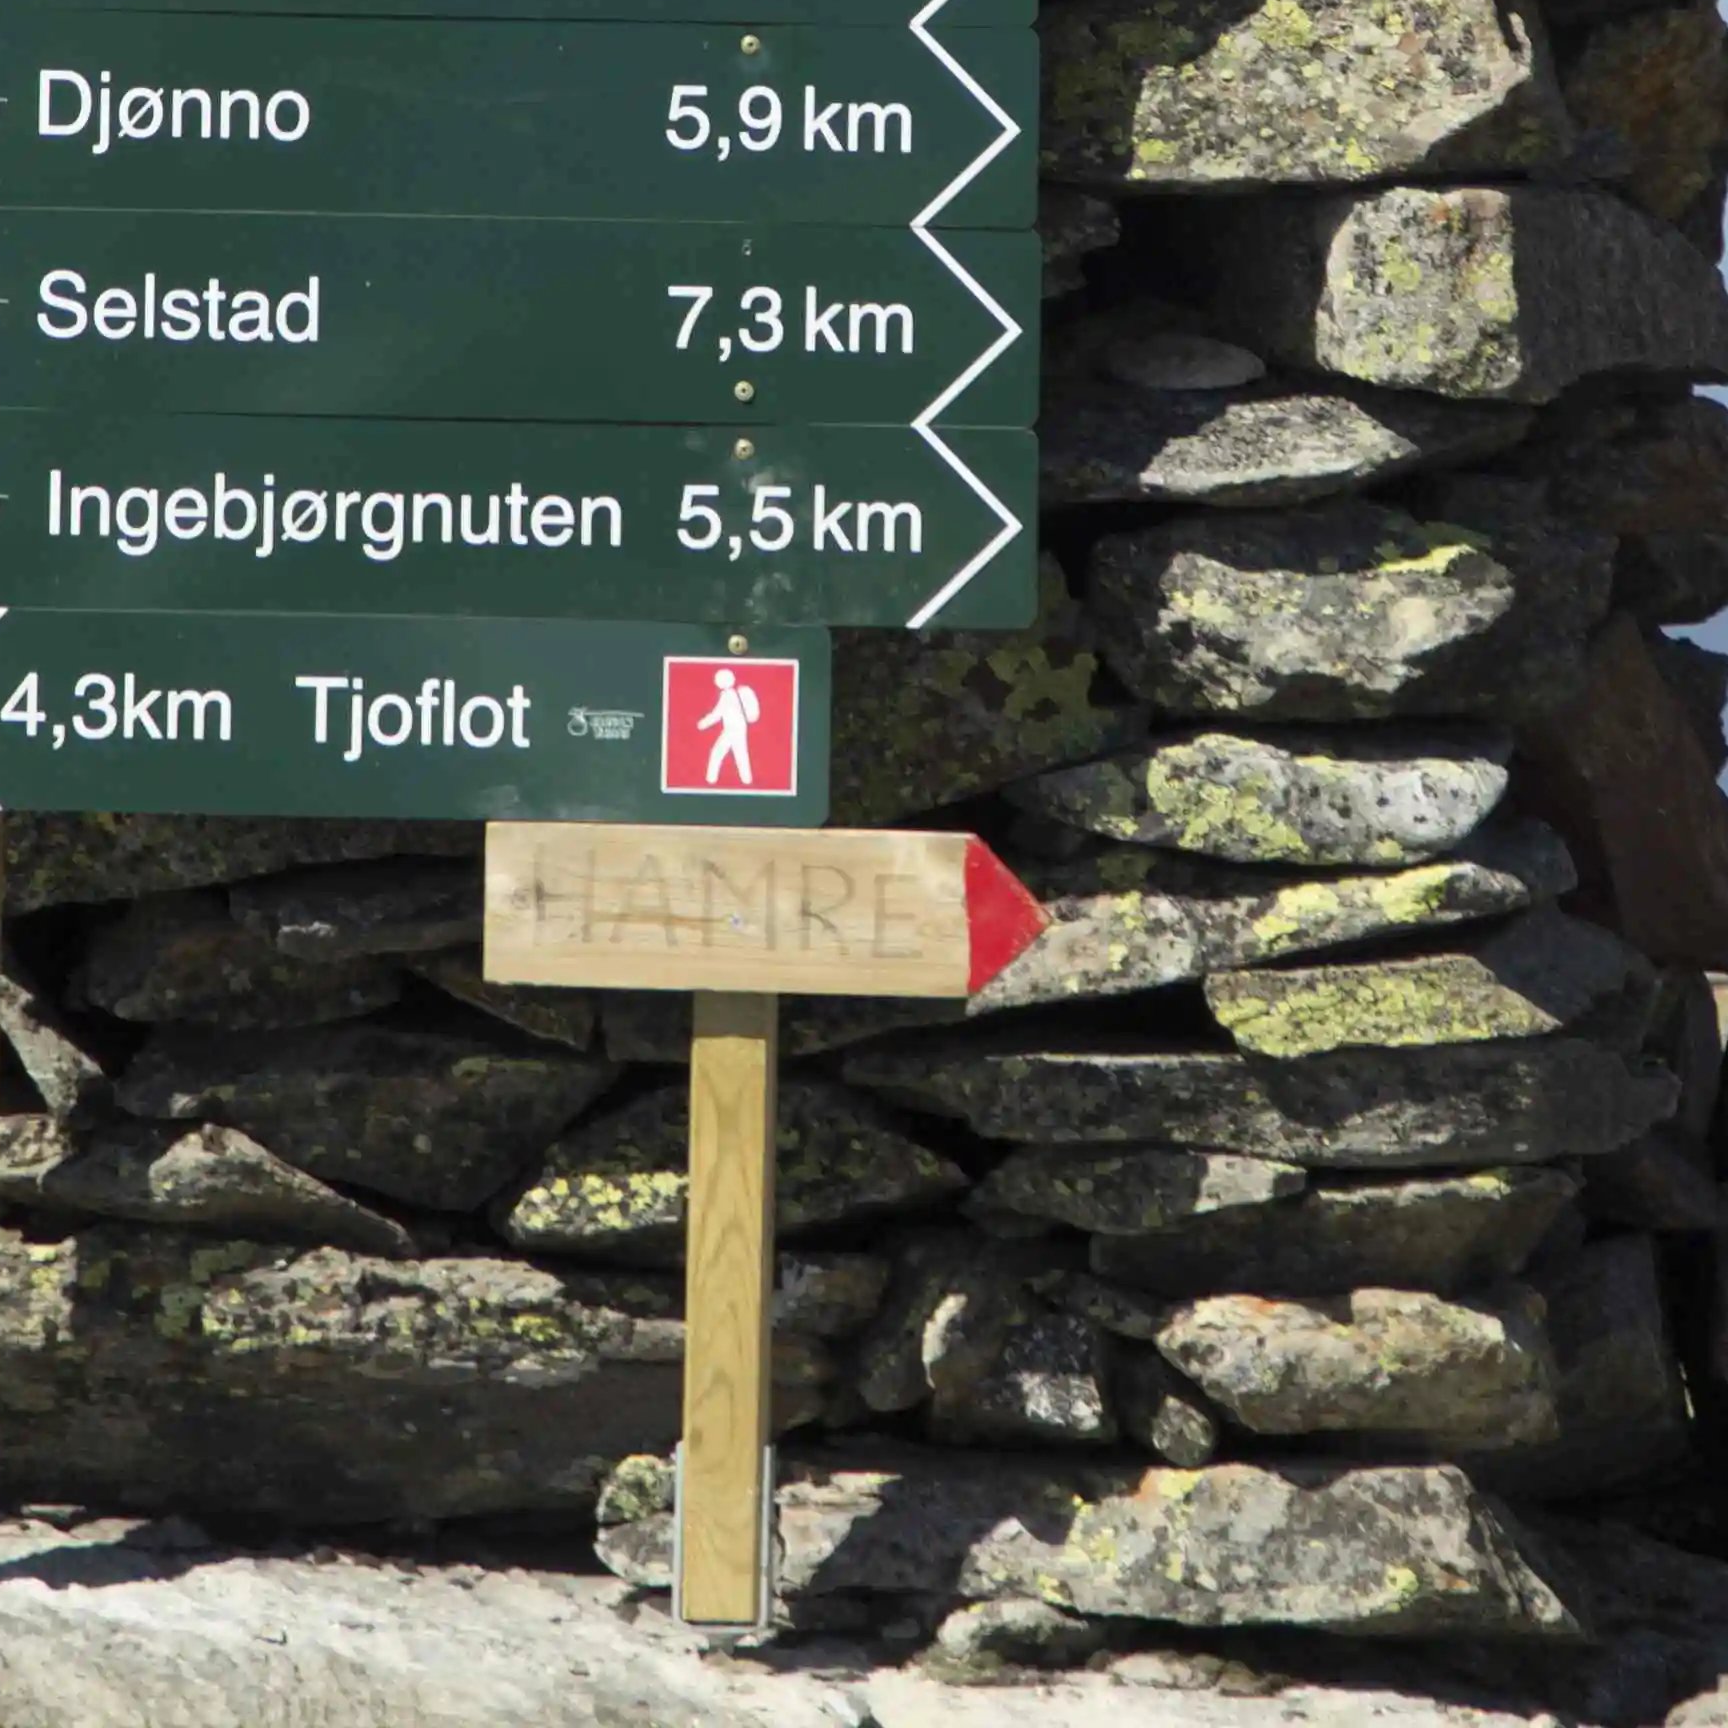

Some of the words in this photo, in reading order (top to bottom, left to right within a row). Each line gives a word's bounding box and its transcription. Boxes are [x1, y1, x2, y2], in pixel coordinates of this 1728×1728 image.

[38, 69, 310, 155] Djønno
[665, 84, 782, 162] 5,9
[804, 85, 912, 153] km
[37, 269, 319, 343] Selstad
[667, 285, 784, 362] 7,3
[805, 285, 914, 354] km
[48, 469, 622, 561] Ingebjørgnuten
[677, 484, 794, 561] 5,5
[813, 484, 922, 553] km
[295, 676, 531, 762] Tjoflot
[528, 838, 927, 960] HAMRE
